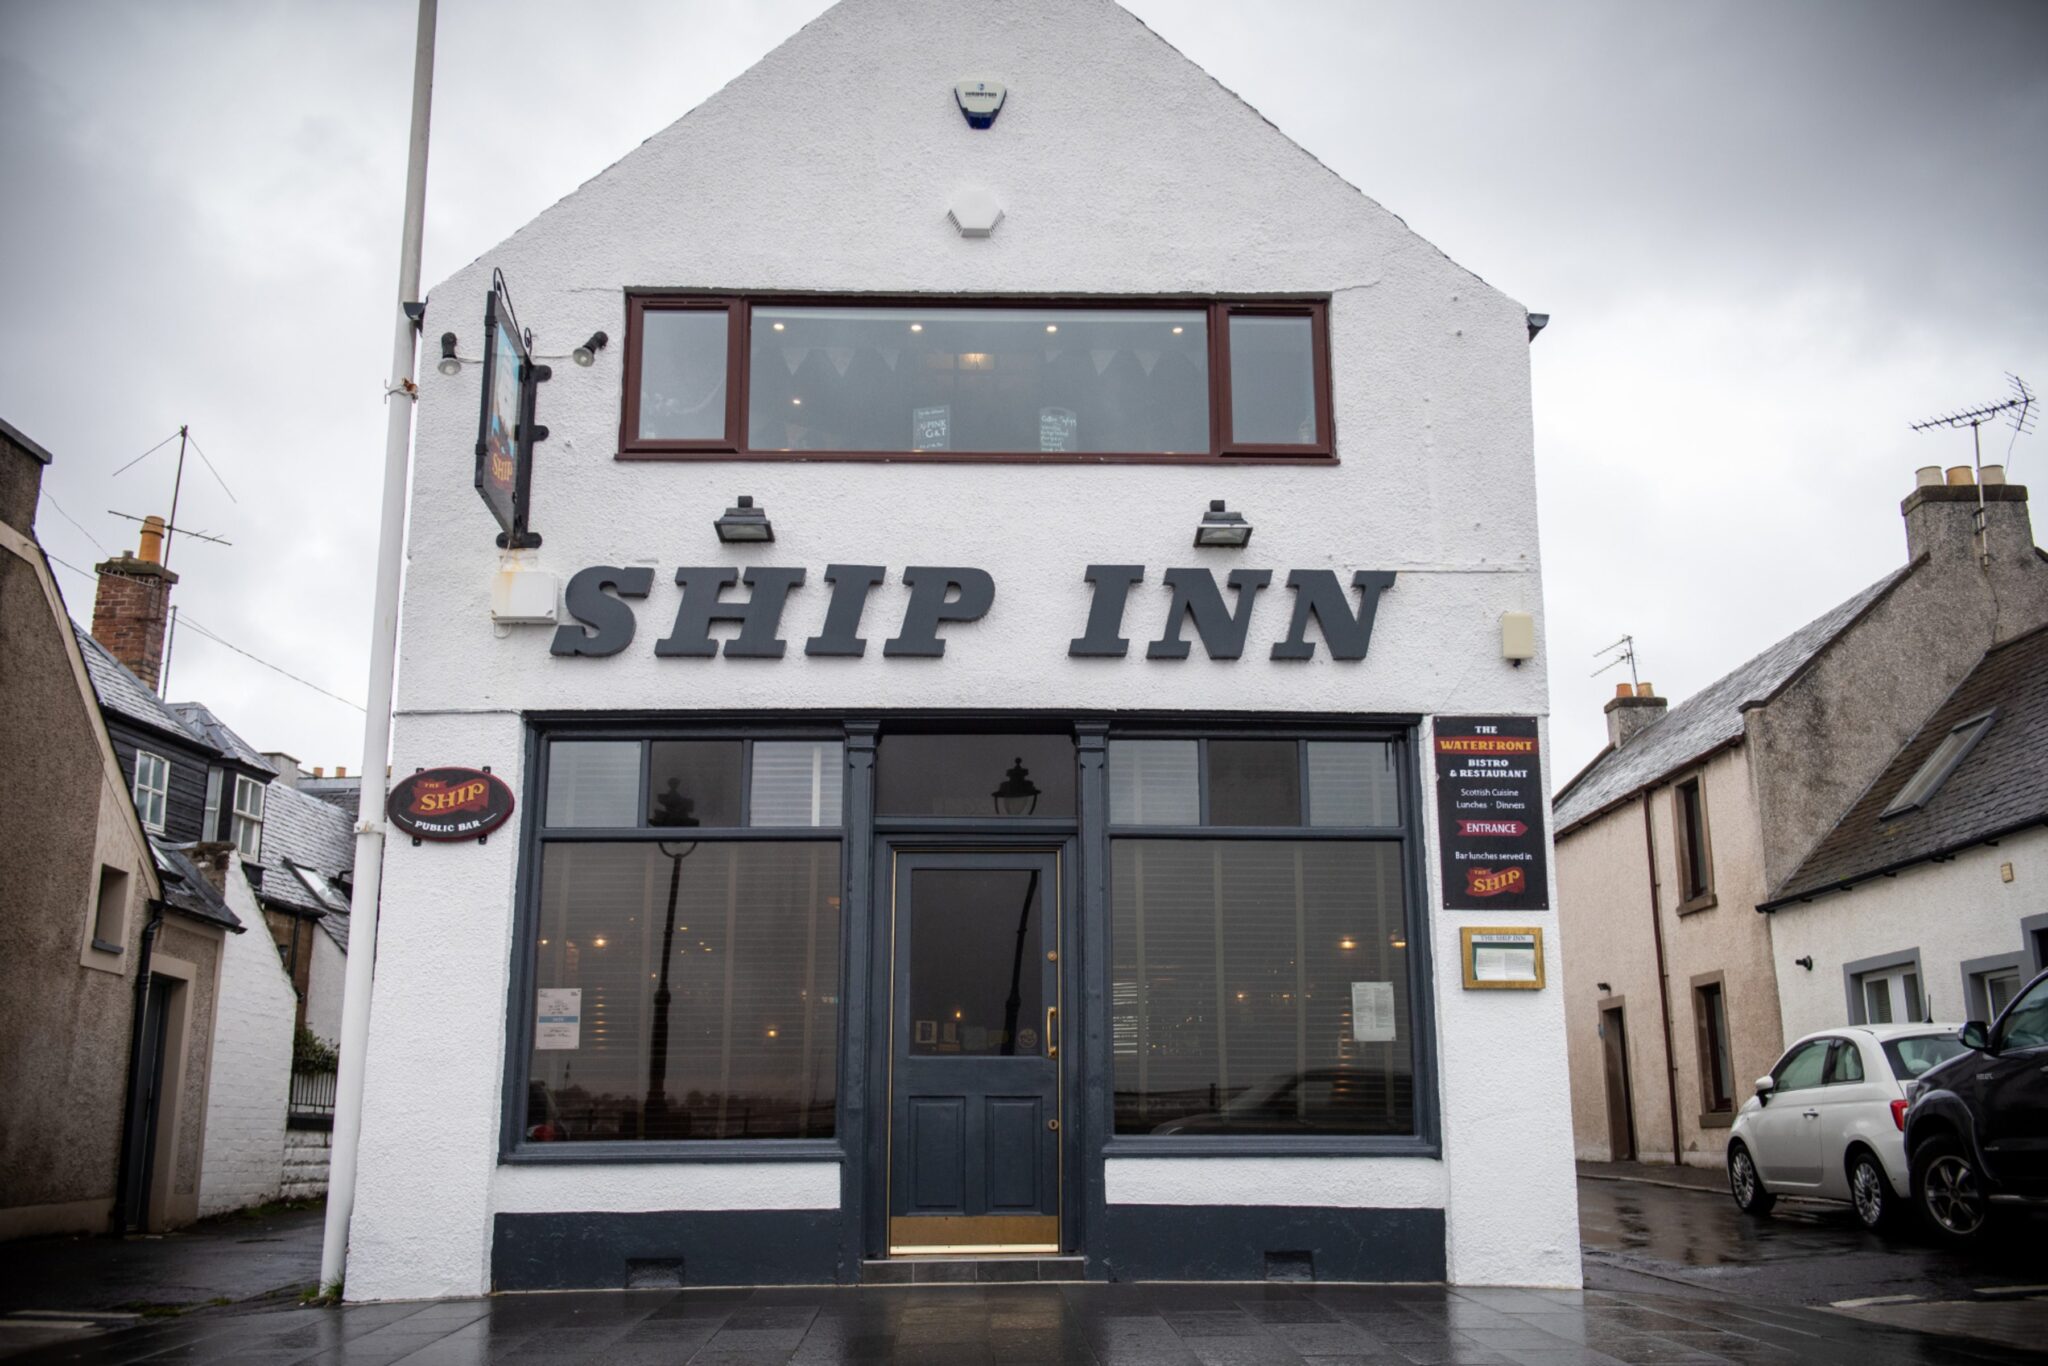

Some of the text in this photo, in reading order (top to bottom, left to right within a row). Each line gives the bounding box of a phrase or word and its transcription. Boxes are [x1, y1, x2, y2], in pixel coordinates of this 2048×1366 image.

[492, 452, 513, 481] SHIP
[550, 564, 1398, 660] SHIP INN
[1475, 725, 1498, 734] THE
[1440, 740, 1533, 751] WATERFRONT
[1468, 759, 1509, 767] BISTRO
[1459, 769, 1528, 778] RESTAURANT
[420, 783, 485, 811] SHIP
[1460, 788, 1519, 796] Scottish Cuisine
[1456, 801, 1525, 809] Lunches Dinners
[414, 820, 481, 832] PUBLIC BAR
[1466, 823, 1517, 833] ENTRANCE
[1455, 851, 1532, 860] Bar lunches served in
[1473, 869, 1520, 893] SHIP
